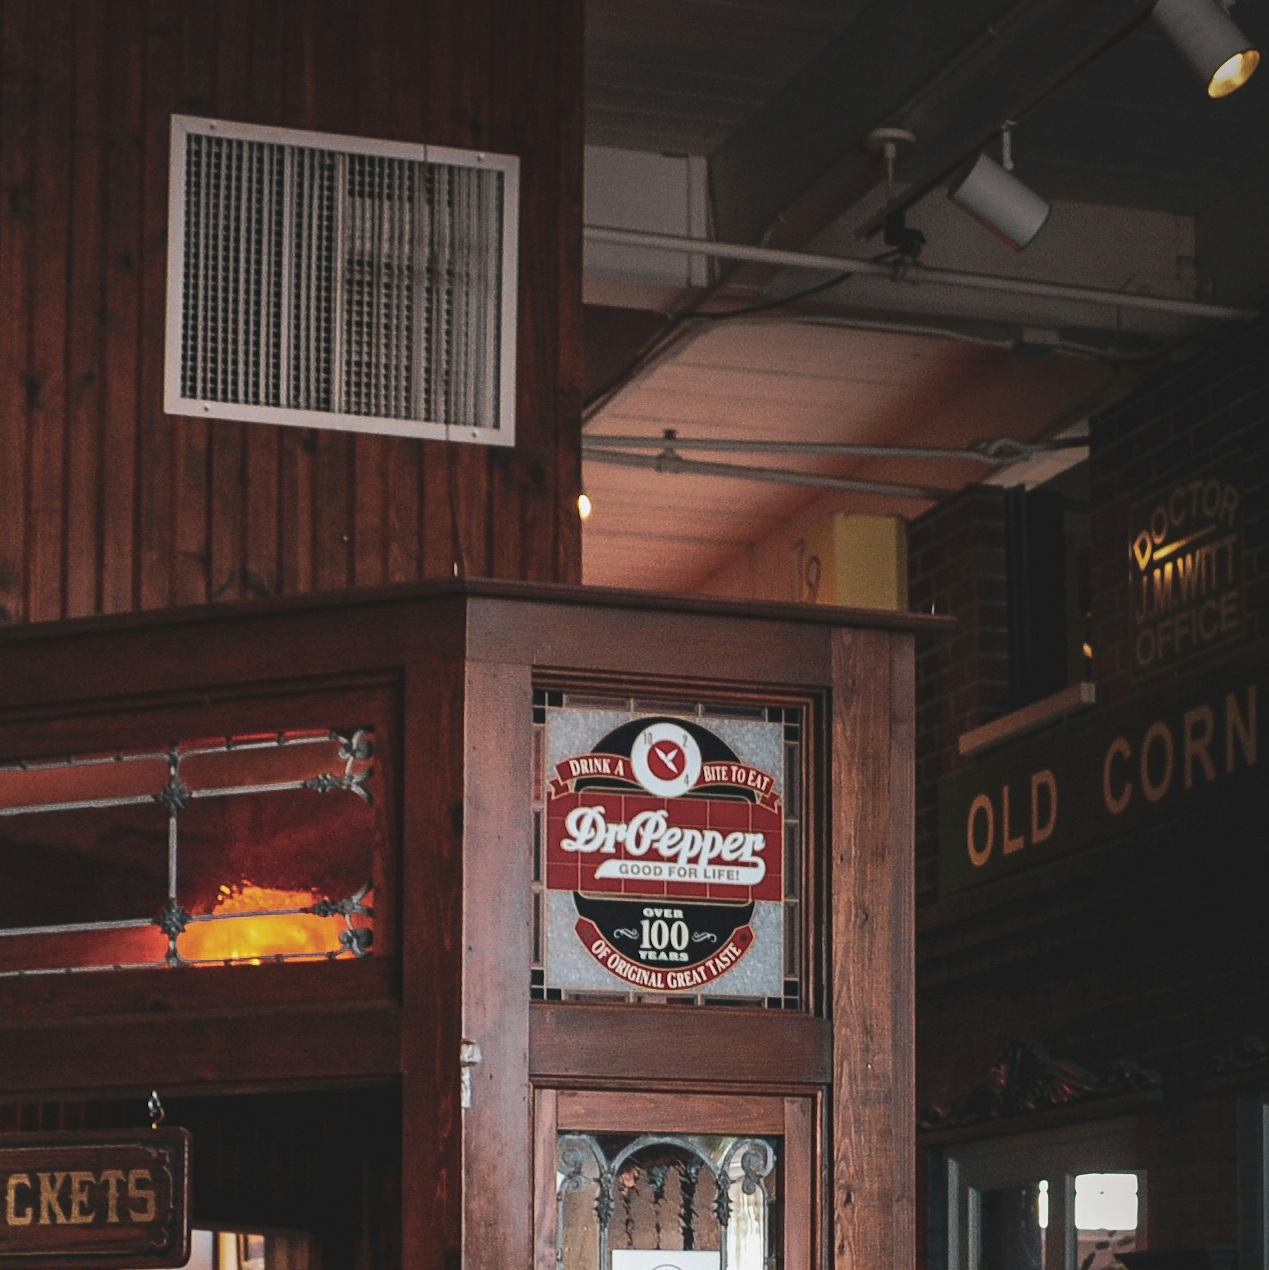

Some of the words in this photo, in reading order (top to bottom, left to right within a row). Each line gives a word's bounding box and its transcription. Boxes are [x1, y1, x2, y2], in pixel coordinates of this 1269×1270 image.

[1134, 588, 1240, 666] OFFICE
[570, 758, 611, 778] DRINK
[614, 759, 625, 776] A
[702, 764, 729, 782] BITE
[731, 766, 747, 783] TO
[748, 770, 771, 792] EAT
[967, 769, 1059, 868] OLD
[619, 863, 663, 876] GOOD
[668, 864, 700, 878] FOR
[703, 867, 740, 881] LIFE!
[642, 907, 684, 919] OVER
[639, 919, 690, 951] 100
[591, 938, 607, 959] OF
[606, 950, 665, 989] ORIGINAL
[666, 967, 707, 989] GREAT
[706, 942, 743, 977] TASTE
[638, 950, 689, 962] YEARS
